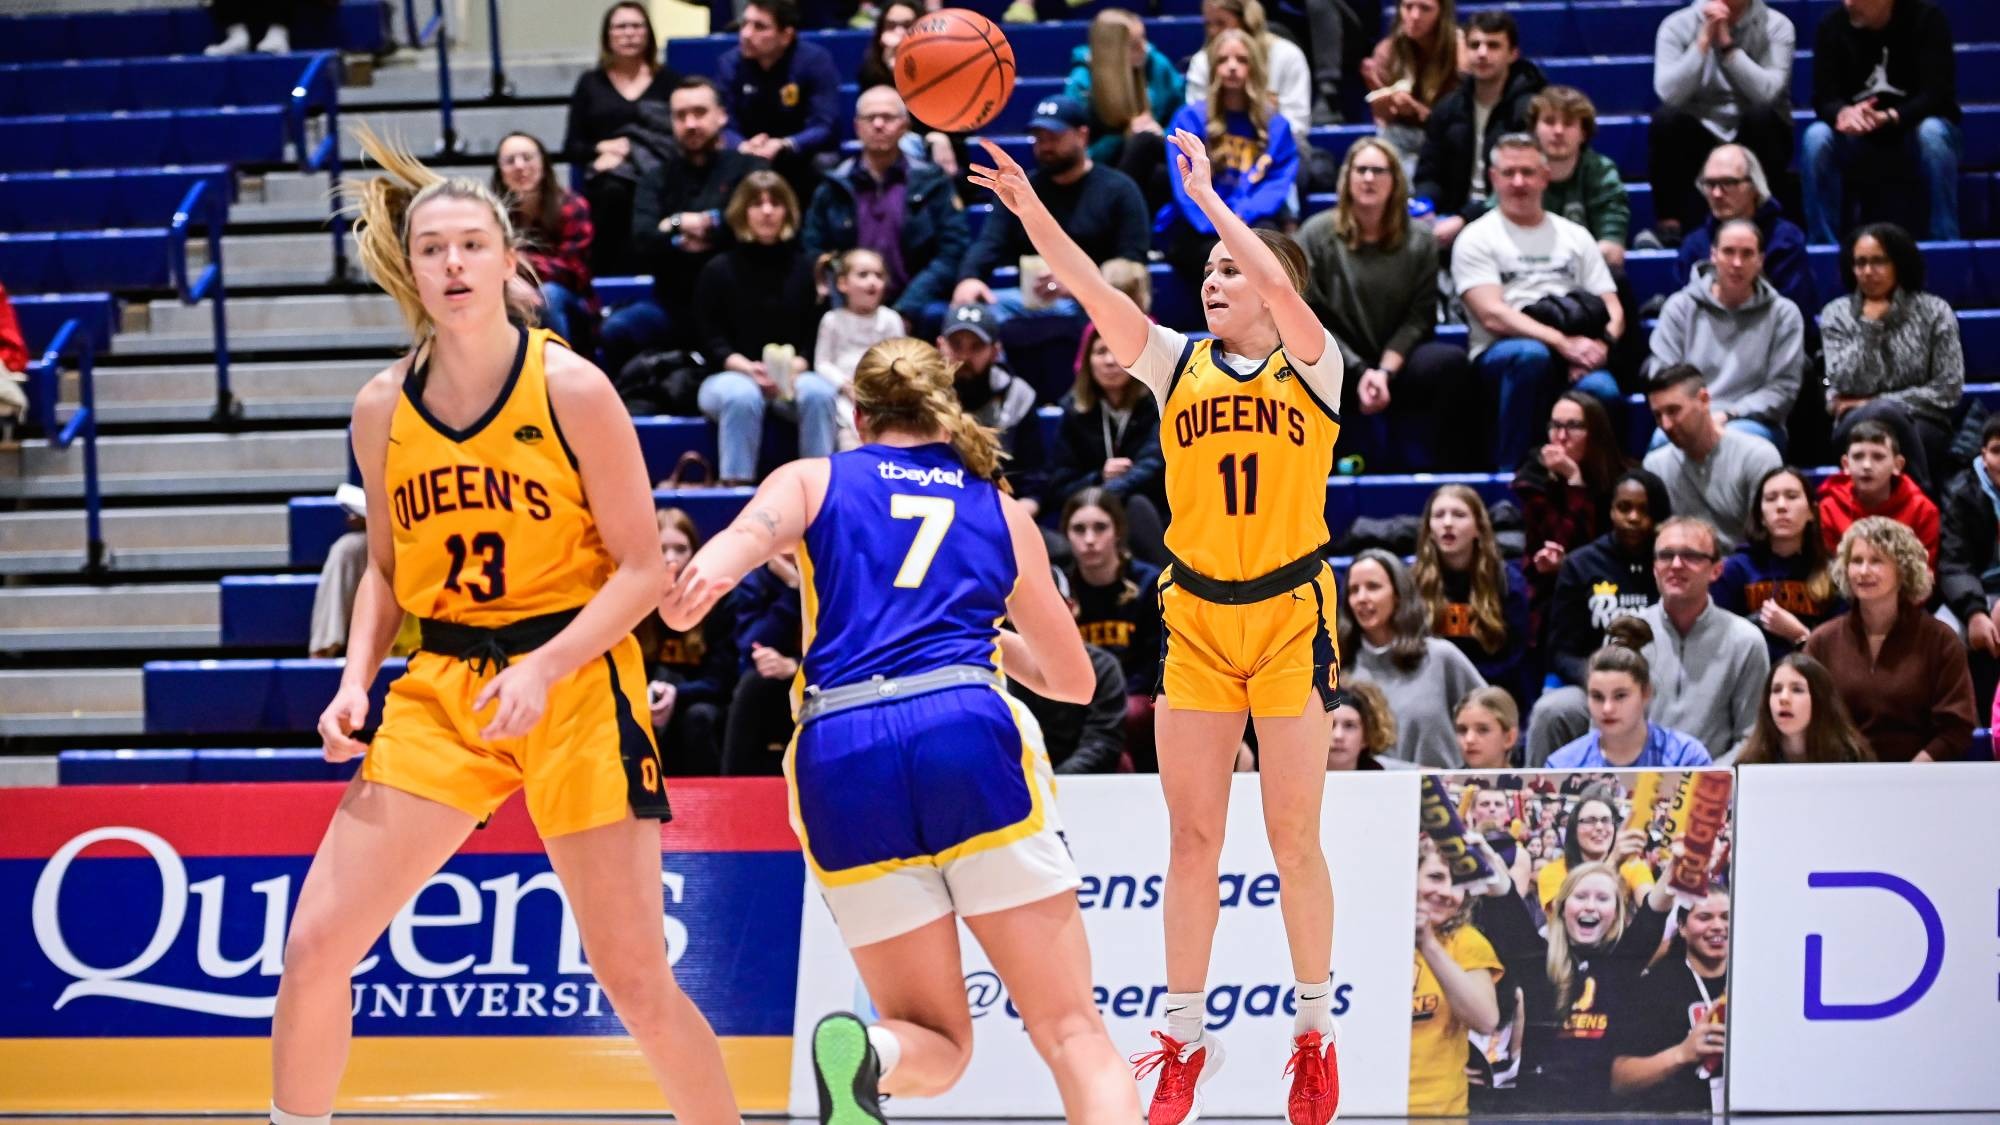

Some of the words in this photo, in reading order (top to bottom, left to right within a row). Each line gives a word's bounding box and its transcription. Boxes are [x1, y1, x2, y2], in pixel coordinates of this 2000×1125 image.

[1174, 394, 1306, 448] QUEEN'S
[393, 464, 553, 532] QUEEN'S
[877, 460, 965, 489] tbaytel
[1217, 451, 1259, 517] 11
[444, 531, 506, 604] 13
[890, 493, 956, 589] 7
[351, 982, 618, 1018] NIVERSI
